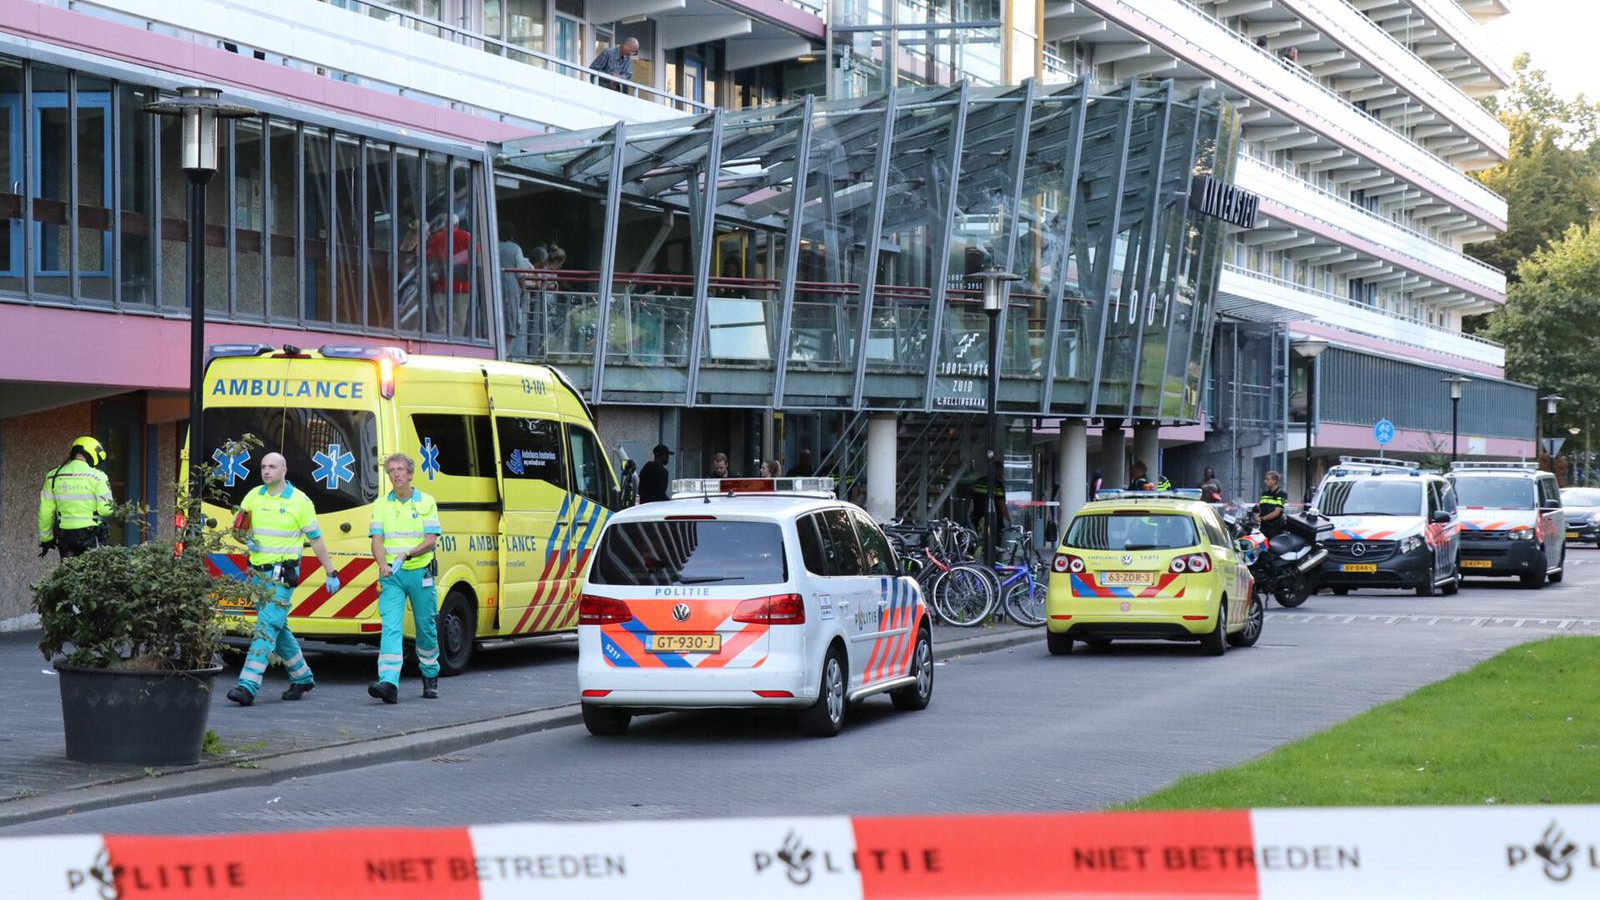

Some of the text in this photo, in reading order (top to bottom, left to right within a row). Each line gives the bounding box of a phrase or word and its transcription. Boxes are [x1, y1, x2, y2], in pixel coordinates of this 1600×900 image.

[212, 379, 364, 399] AMBULANCE
[952, 380, 973, 392] ZUID
[1107, 572, 1151, 582] 63-ZDR-3
[655, 588, 710, 597] POLITIE
[657, 636, 715, 649] GT-930-J
[1073, 845, 1361, 871] NIET BETREDEN
[365, 853, 627, 882] NIET BETREDEN
